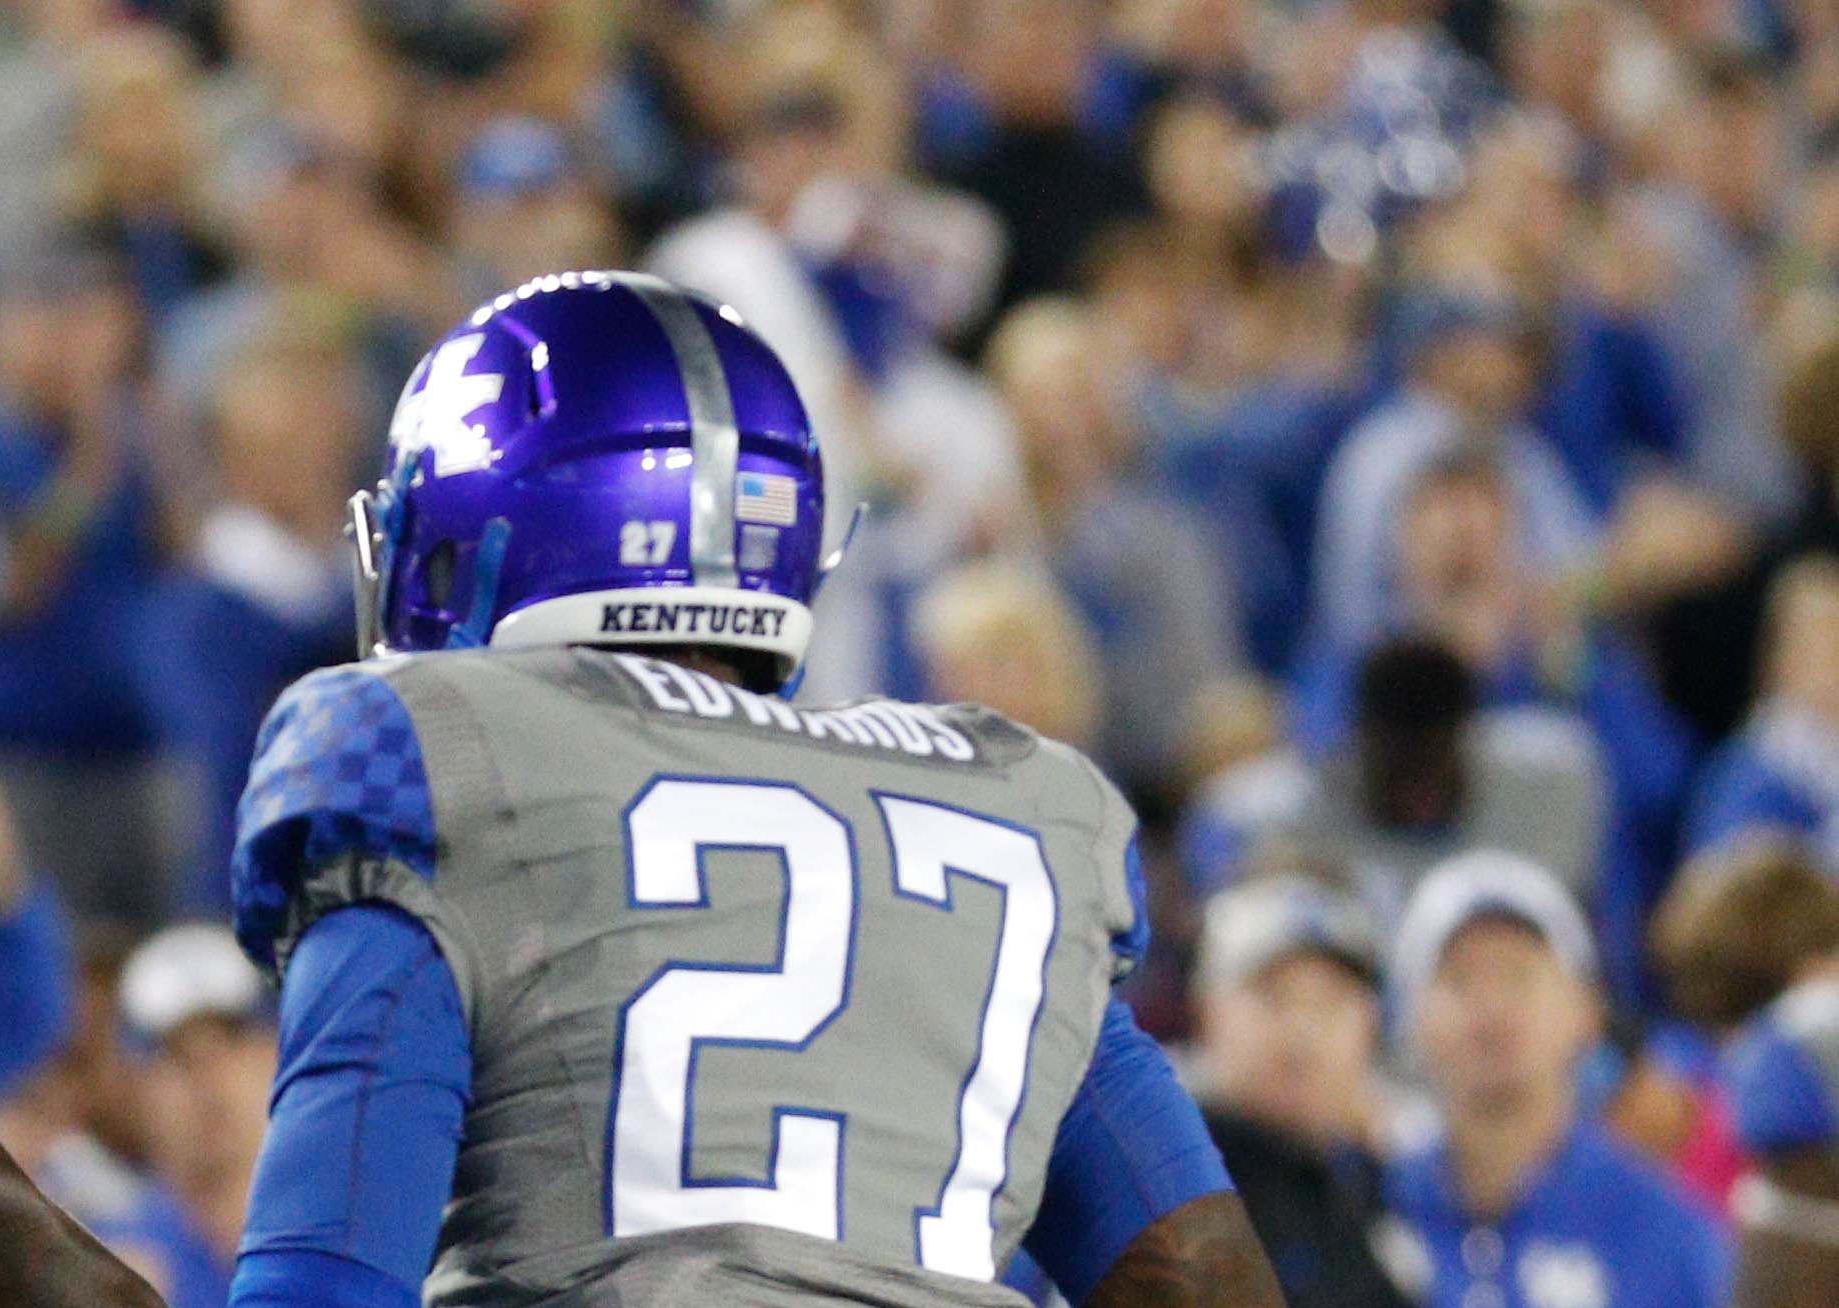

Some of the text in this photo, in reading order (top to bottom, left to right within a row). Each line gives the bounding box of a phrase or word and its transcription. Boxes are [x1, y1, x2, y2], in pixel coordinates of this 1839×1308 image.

[620, 520, 677, 567] 27
[601, 604, 788, 637] KENTUCKY
[603, 772, 1060, 1284] 27
